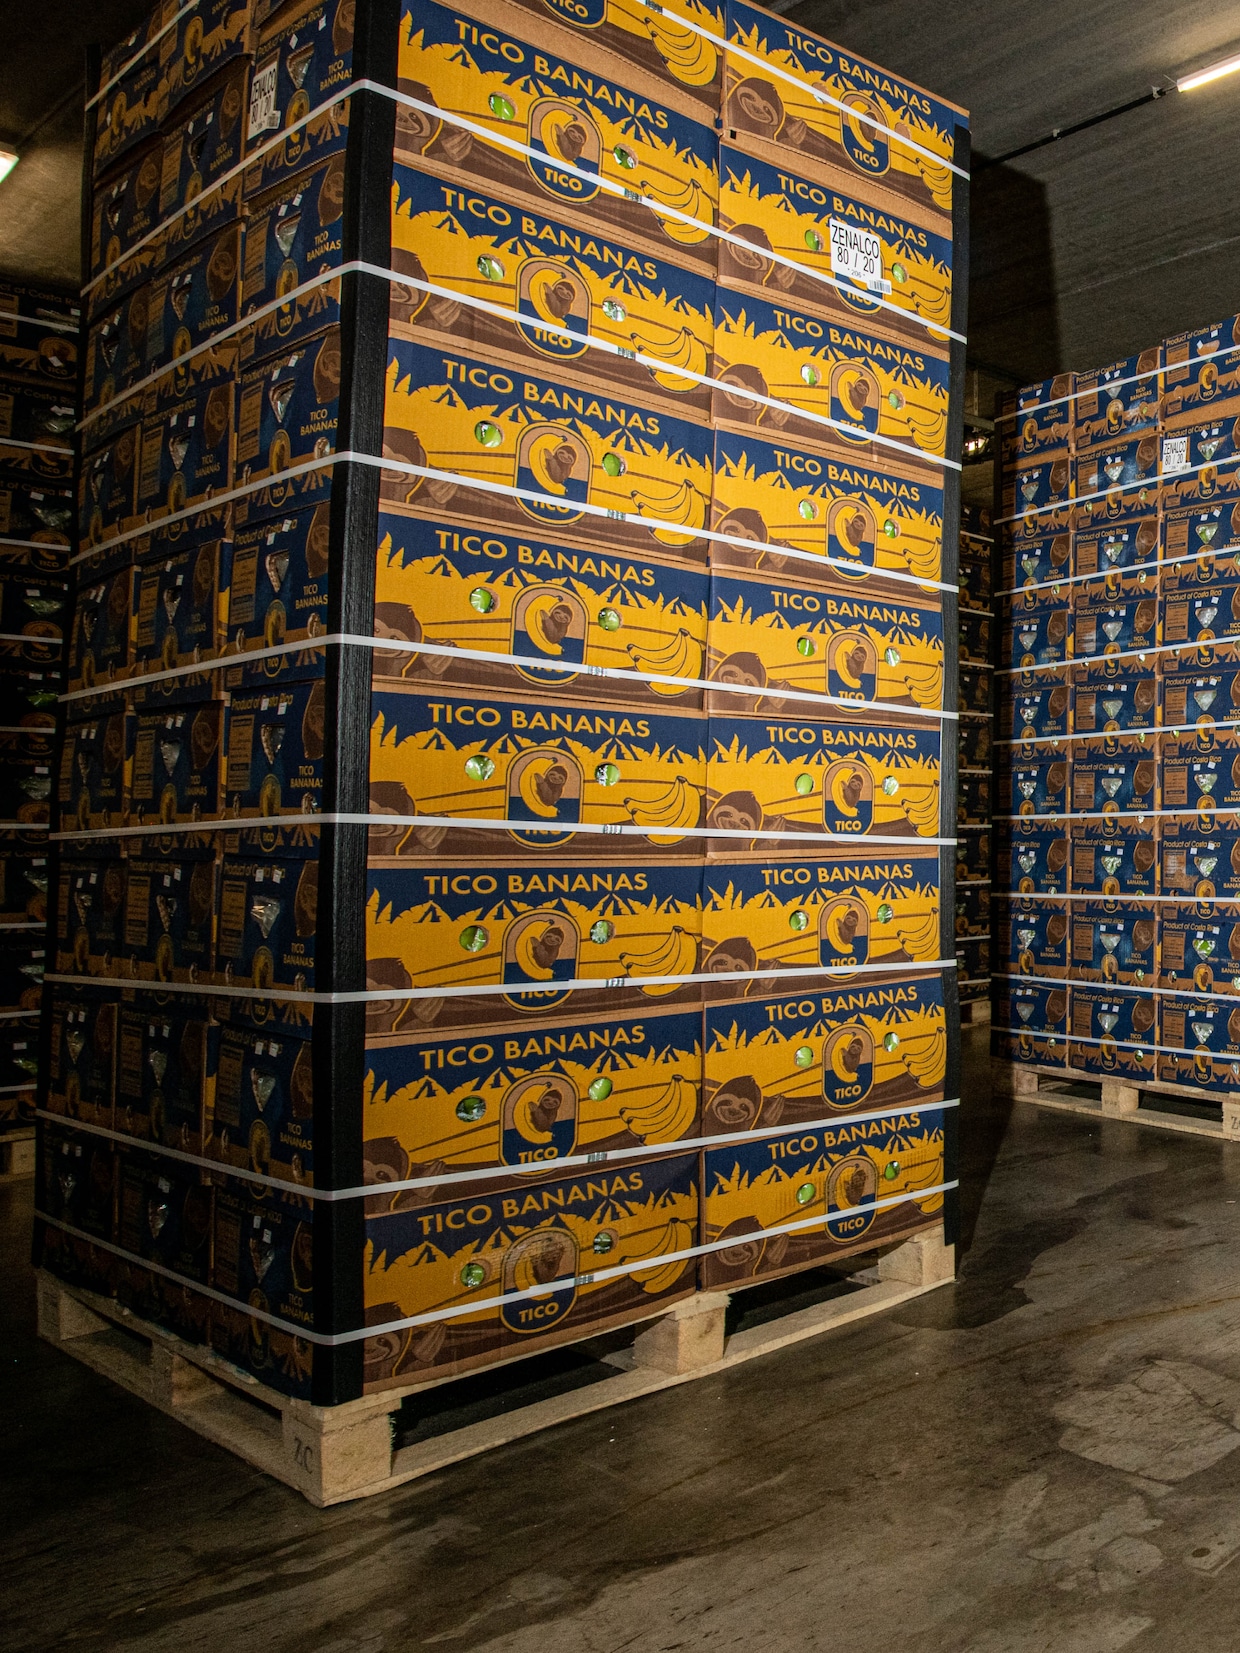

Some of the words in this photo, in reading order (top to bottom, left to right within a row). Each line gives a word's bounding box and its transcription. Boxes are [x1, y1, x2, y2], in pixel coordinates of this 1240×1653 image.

[328, 59, 344, 74] TICO
[455, 19, 524, 63] TICO
[535, 55, 668, 129] BANANAS
[785, 30, 833, 64] TICO
[839, 57, 931, 115] BANANAS
[320, 67, 352, 91] BANANAS
[853, 148, 879, 167] TICO
[544, 167, 582, 191] TICO
[777, 174, 826, 205] TICO
[833, 197, 927, 247] BANANAS
[314, 230, 329, 245] TICO
[441, 186, 511, 226] TICO
[522, 216, 657, 279] BANANAS
[832, 224, 879, 259] ZENALCO
[306, 239, 341, 262] BANANAS
[837, 246, 849, 265] 80
[863, 256, 875, 274] 20
[532, 327, 571, 349] TICO
[773, 310, 823, 337] TICO
[829, 328, 924, 371] BANANAS
[1166, 335, 1186, 345] Product
[1188, 332, 1193, 340] of
[1193, 327, 1209, 337] Costa
[1210, 323, 1223, 332] Rica
[442, 359, 513, 393] TICO
[524, 382, 660, 435] BANANAS
[310, 408, 328, 421] TICO
[300, 418, 338, 436] BANANAS
[773, 450, 822, 476] TICO
[828, 464, 920, 501] BANANAS
[435, 530, 507, 559] TICO
[518, 545, 655, 586] BANANAS
[303, 584, 318, 595] TICO
[1166, 593, 1186, 601] Product
[1193, 591, 1209, 599] Costa
[295, 594, 328, 609] BANANAS
[771, 591, 820, 612] TICO
[827, 599, 920, 627] BANANAS
[428, 703, 501, 726] TICO
[512, 710, 650, 737] BANANAS
[766, 726, 816, 744] TICO
[822, 729, 916, 749] BANANAS
[835, 820, 862, 831] TICO
[424, 875, 497, 895] TICO
[508, 873, 648, 893] BANANAS
[761, 868, 811, 885] TICO
[817, 864, 913, 883] BANANAS
[829, 957, 857, 967] TICO
[765, 1000, 815, 1021] TICO
[822, 986, 917, 1014] BANANAS
[1163, 1000, 1184, 1009] Product
[1184, 1002, 1190, 1010] of
[1190, 1003, 1206, 1012] Costa
[1206, 1005, 1219, 1013] Rica
[419, 1044, 494, 1070] TICO
[505, 1025, 645, 1059] BANANAS
[835, 1085, 861, 1099] TICO
[767, 1136, 818, 1159] TICO
[823, 1112, 921, 1152] BANANAS
[518, 1147, 558, 1164] TICO
[417, 1204, 492, 1235] TICO
[502, 1170, 643, 1218] BANANAS
[838, 1217, 865, 1233] TICO
[519, 1302, 559, 1323] TICO
